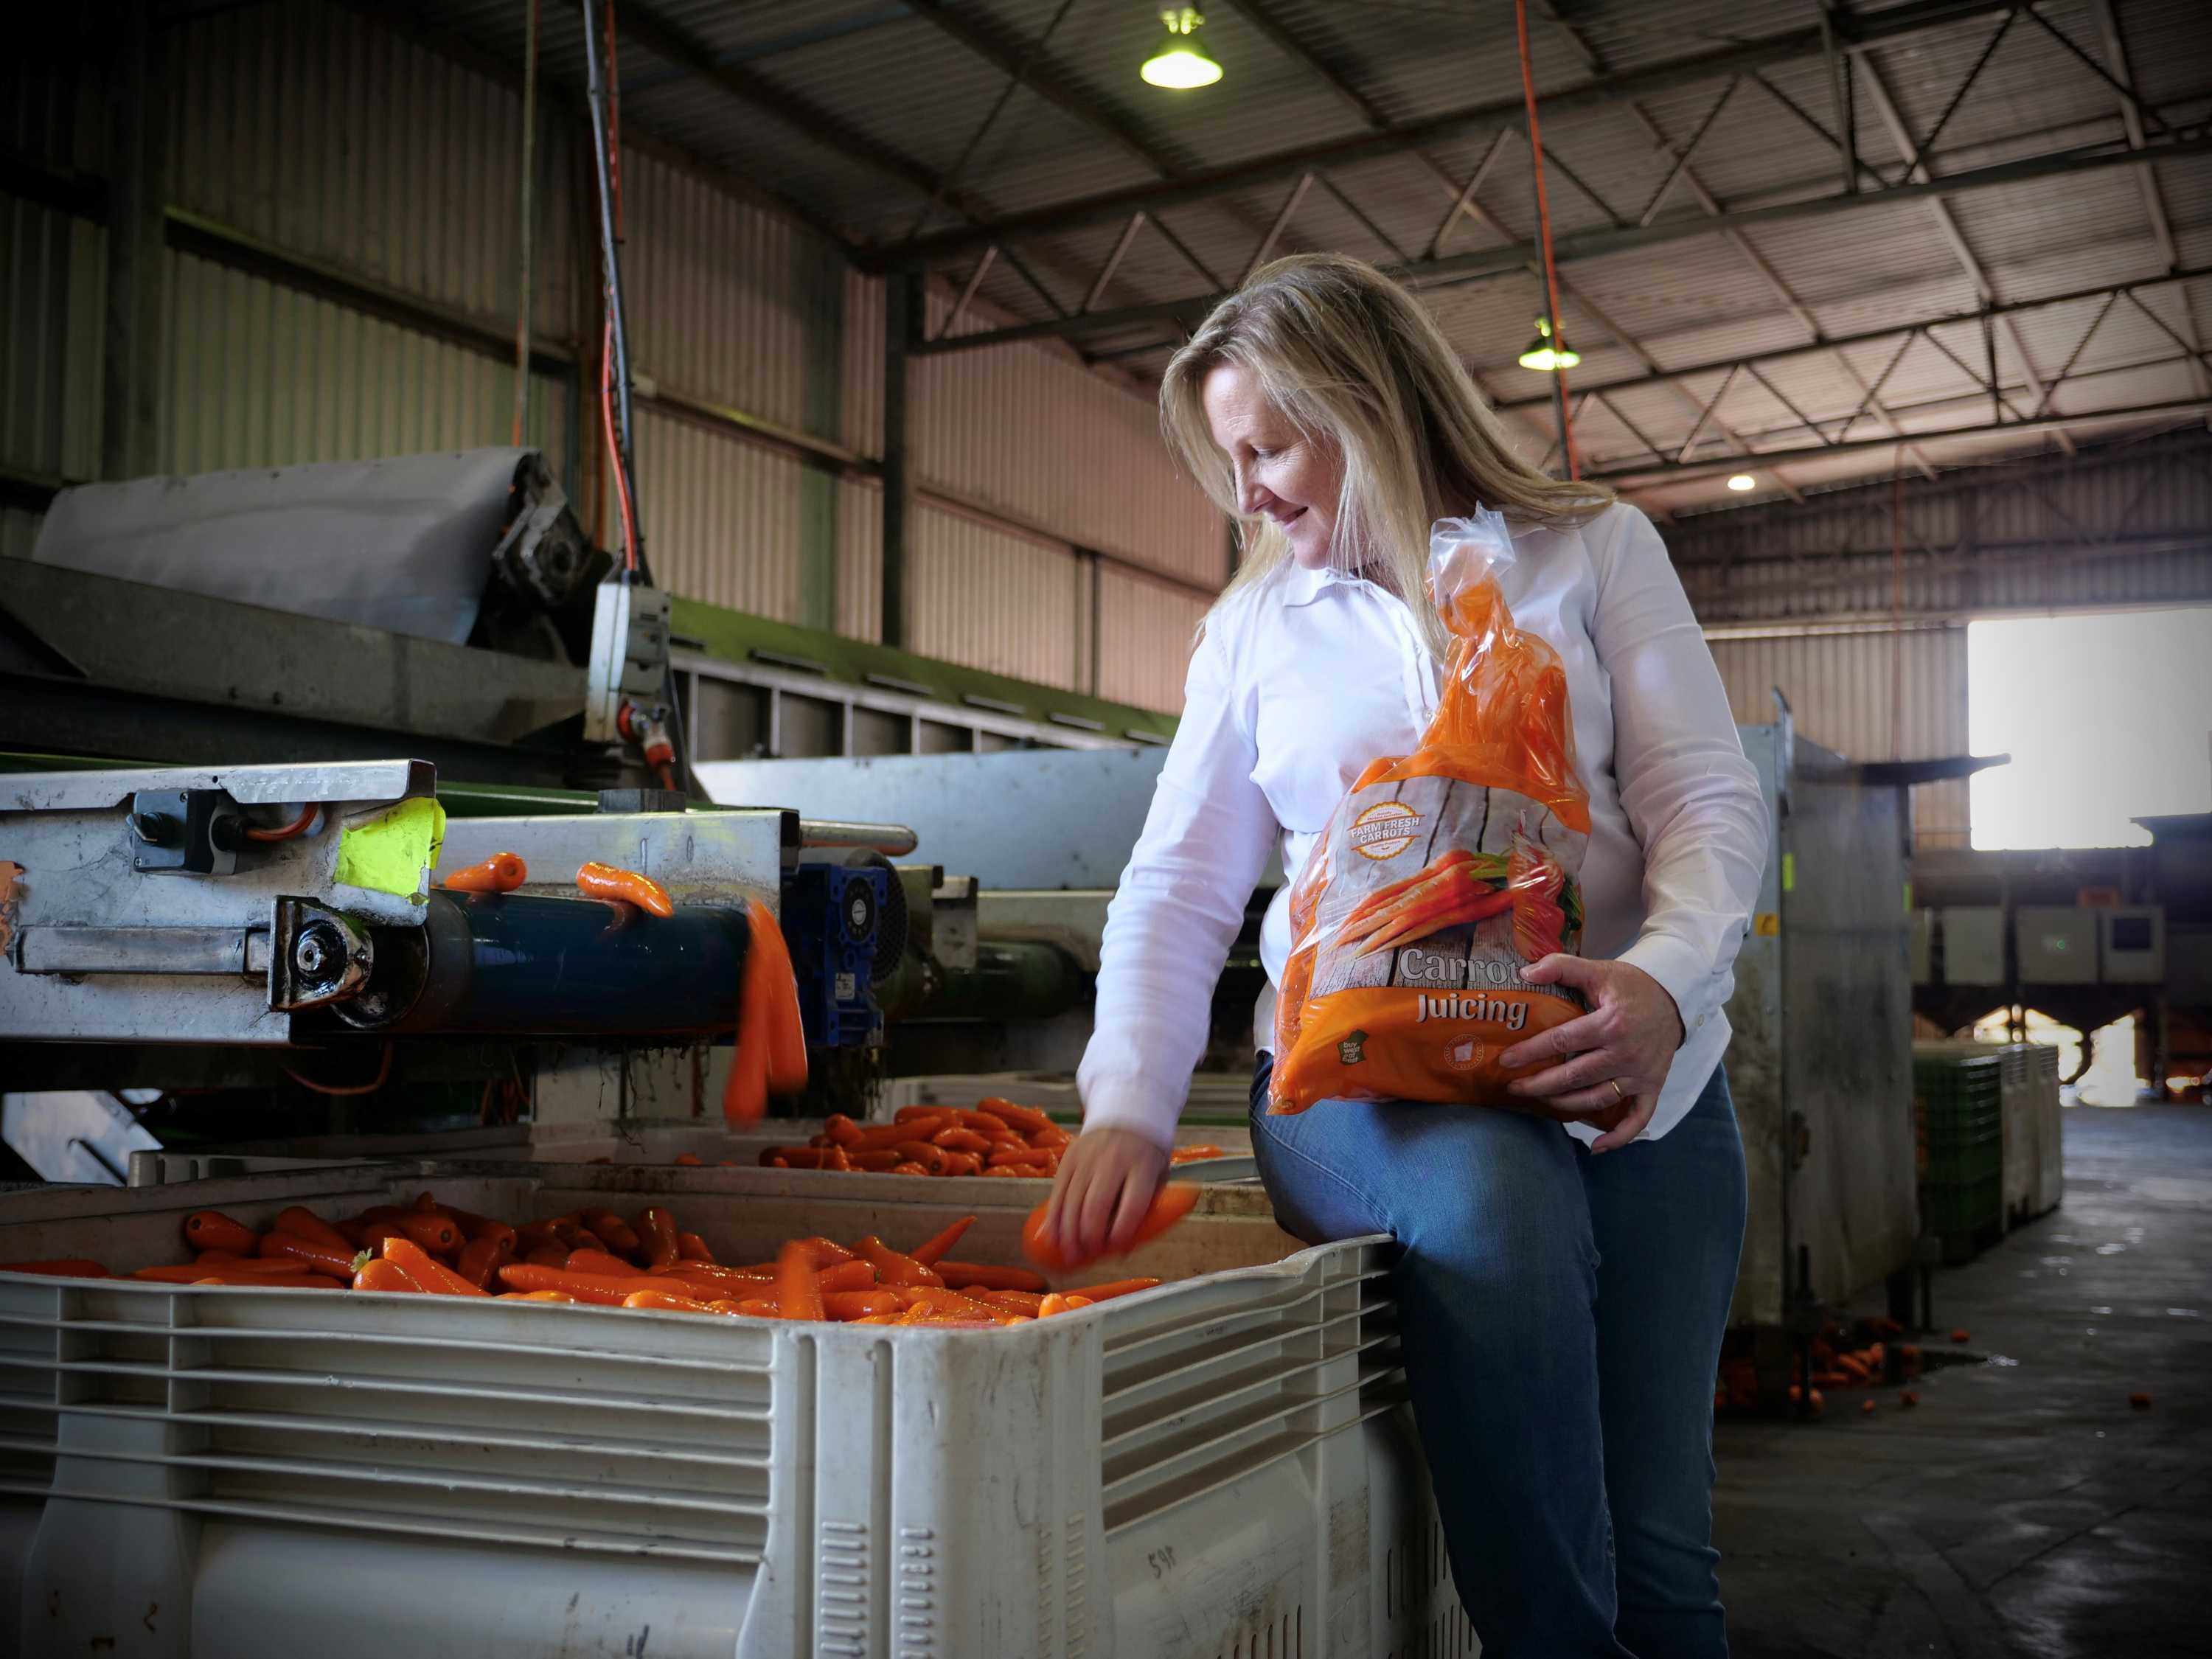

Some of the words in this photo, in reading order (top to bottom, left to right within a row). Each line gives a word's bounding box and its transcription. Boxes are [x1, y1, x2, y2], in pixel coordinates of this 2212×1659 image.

[1352, 823, 1381, 838] FARM
[1385, 818, 1420, 829] FRESH
[1360, 827, 1411, 844] CARROTS
[1416, 992, 1529, 1032] Juicing
